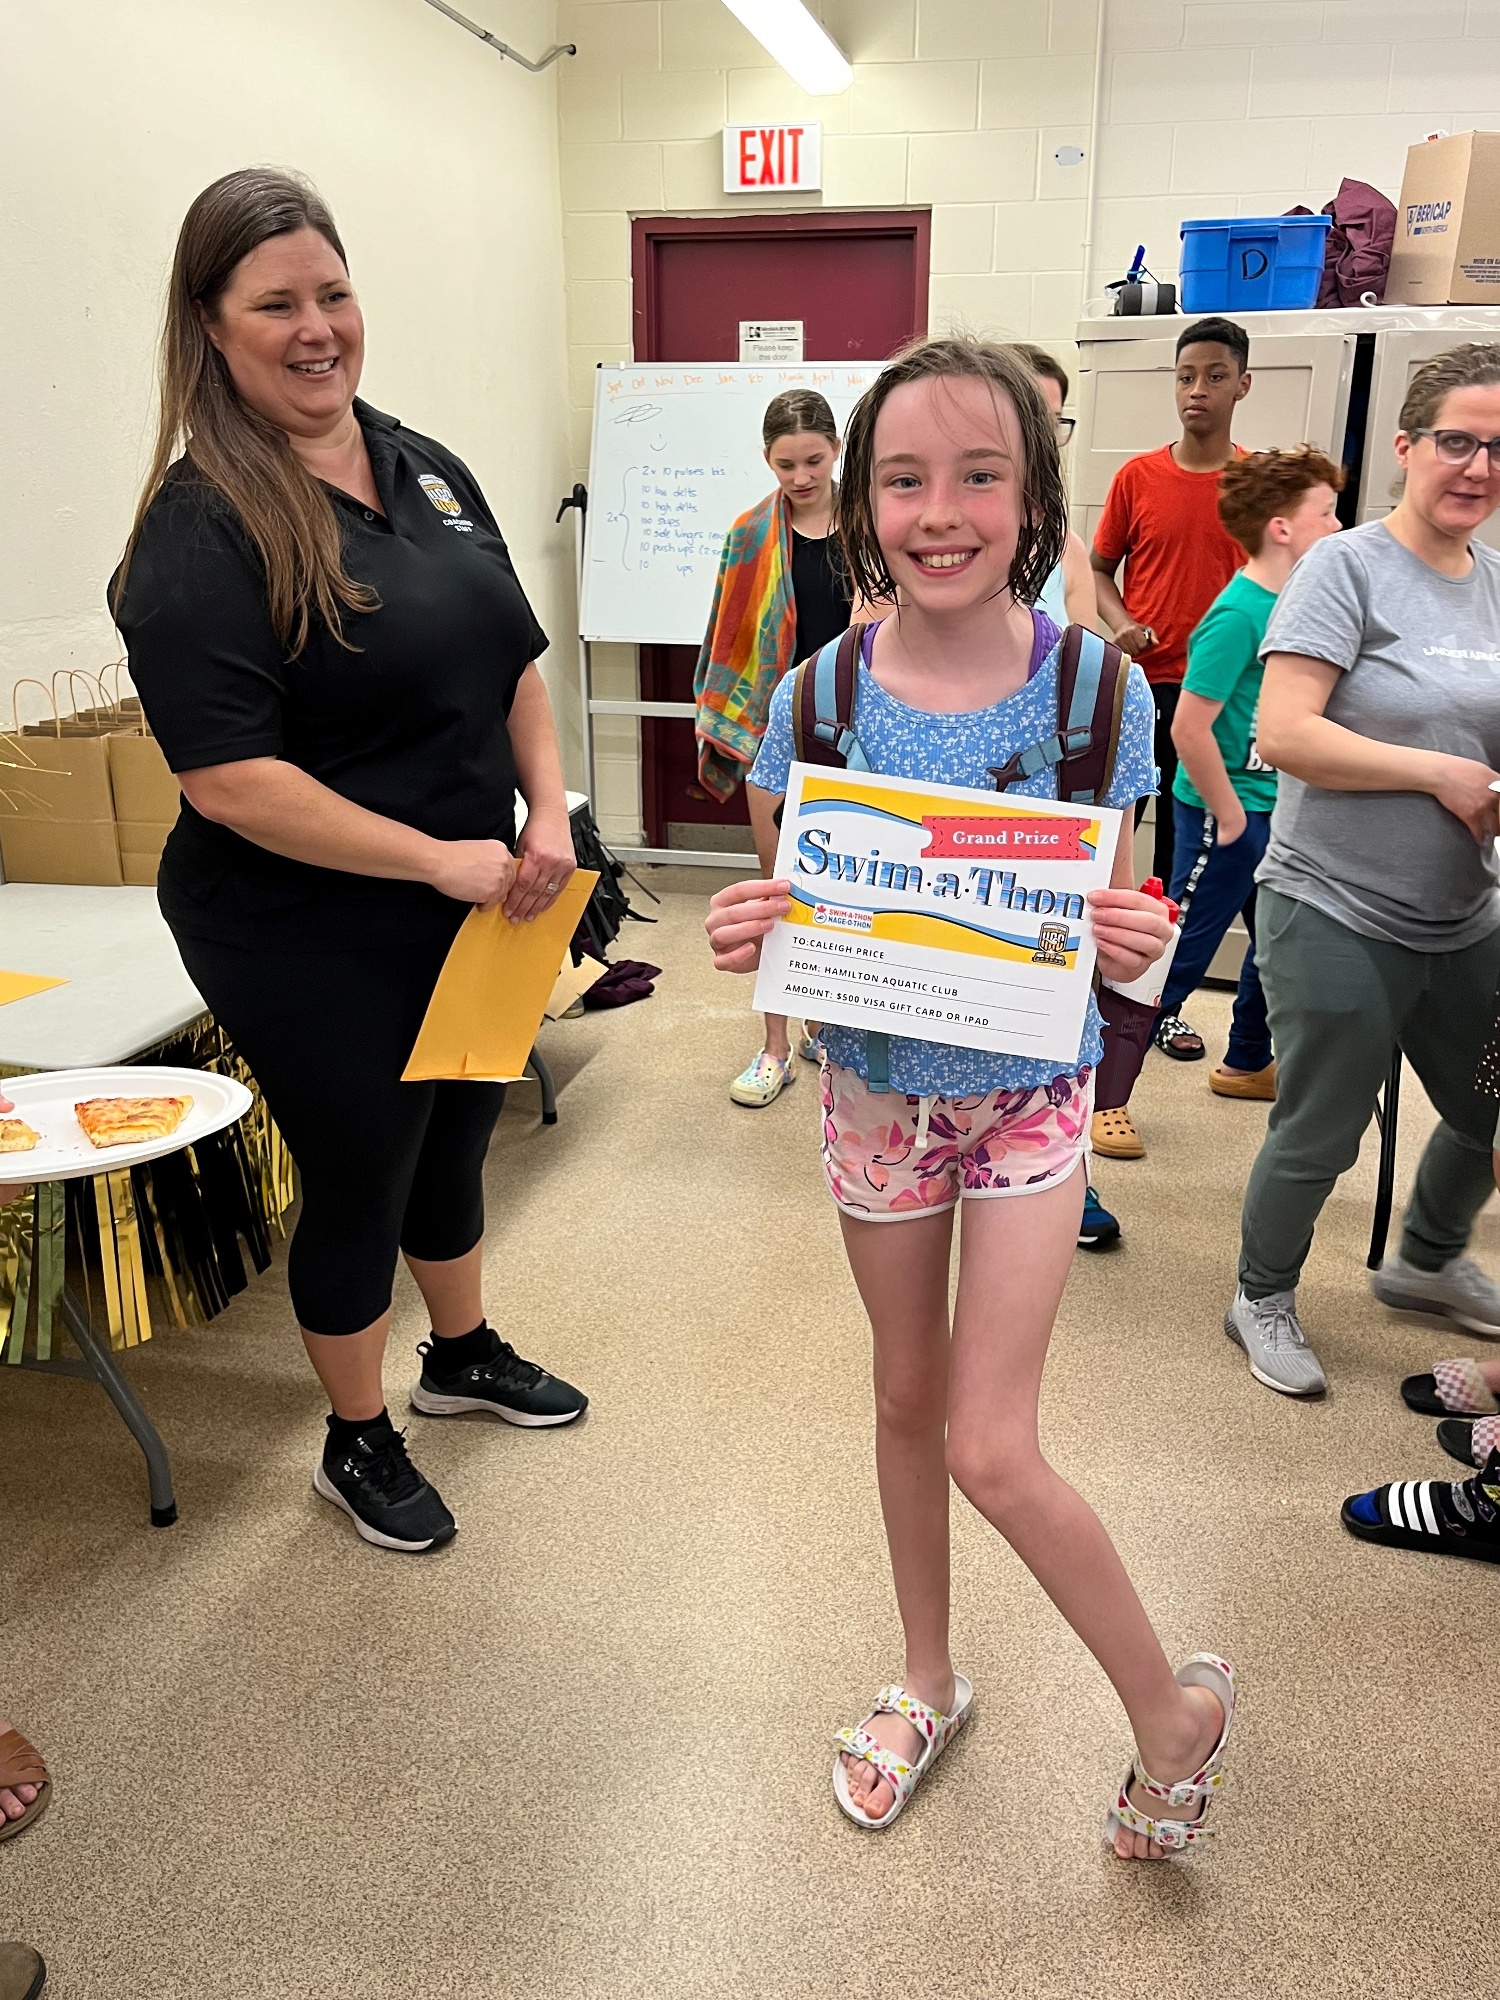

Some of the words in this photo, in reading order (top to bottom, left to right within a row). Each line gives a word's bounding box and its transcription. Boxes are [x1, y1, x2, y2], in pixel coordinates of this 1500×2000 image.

[739, 128, 804, 186] EXIT
[1416, 201, 1452, 223] BERICAP
[1241, 248, 1269, 281] D
[753, 344, 777, 352] Please
[777, 344, 795, 353] keep
[655, 376, 674, 388] Nov
[684, 374, 704, 386] Dec
[715, 373, 738, 386] Jan
[812, 369, 835, 388] April
[663, 467, 672, 476] 10
[674, 467, 705, 480] pulses
[641, 484, 651, 494] 10
[641, 501, 650, 510] 10
[643, 528, 652, 537] 10
[639, 541, 650, 553] 10
[652, 541, 676, 556] push
[677, 546, 695, 558] ups
[639, 559, 649, 571] 10
[676, 564, 694, 578] ups
[1422, 645, 1468, 659] UNDER
[952, 829, 1008, 846] Grand
[1013, 830, 1060, 846] Prize
[856, 947, 885, 960] PRICE
[789, 960, 821, 973] FROM:
[825, 966, 879, 983] HAMILTON
[882, 976, 928, 992] AQUATIC
[931, 985, 958, 997] CLUB
[785, 983, 833, 999] AMOUNT:
[837, 992, 860, 1004] $500
[863, 997, 886, 1009] VISA
[889, 1002, 912, 1013] GIFT
[915, 1006, 943, 1018] CARD
[946, 1012, 961, 1021] OR
[965, 1015, 989, 1026] IPAD
